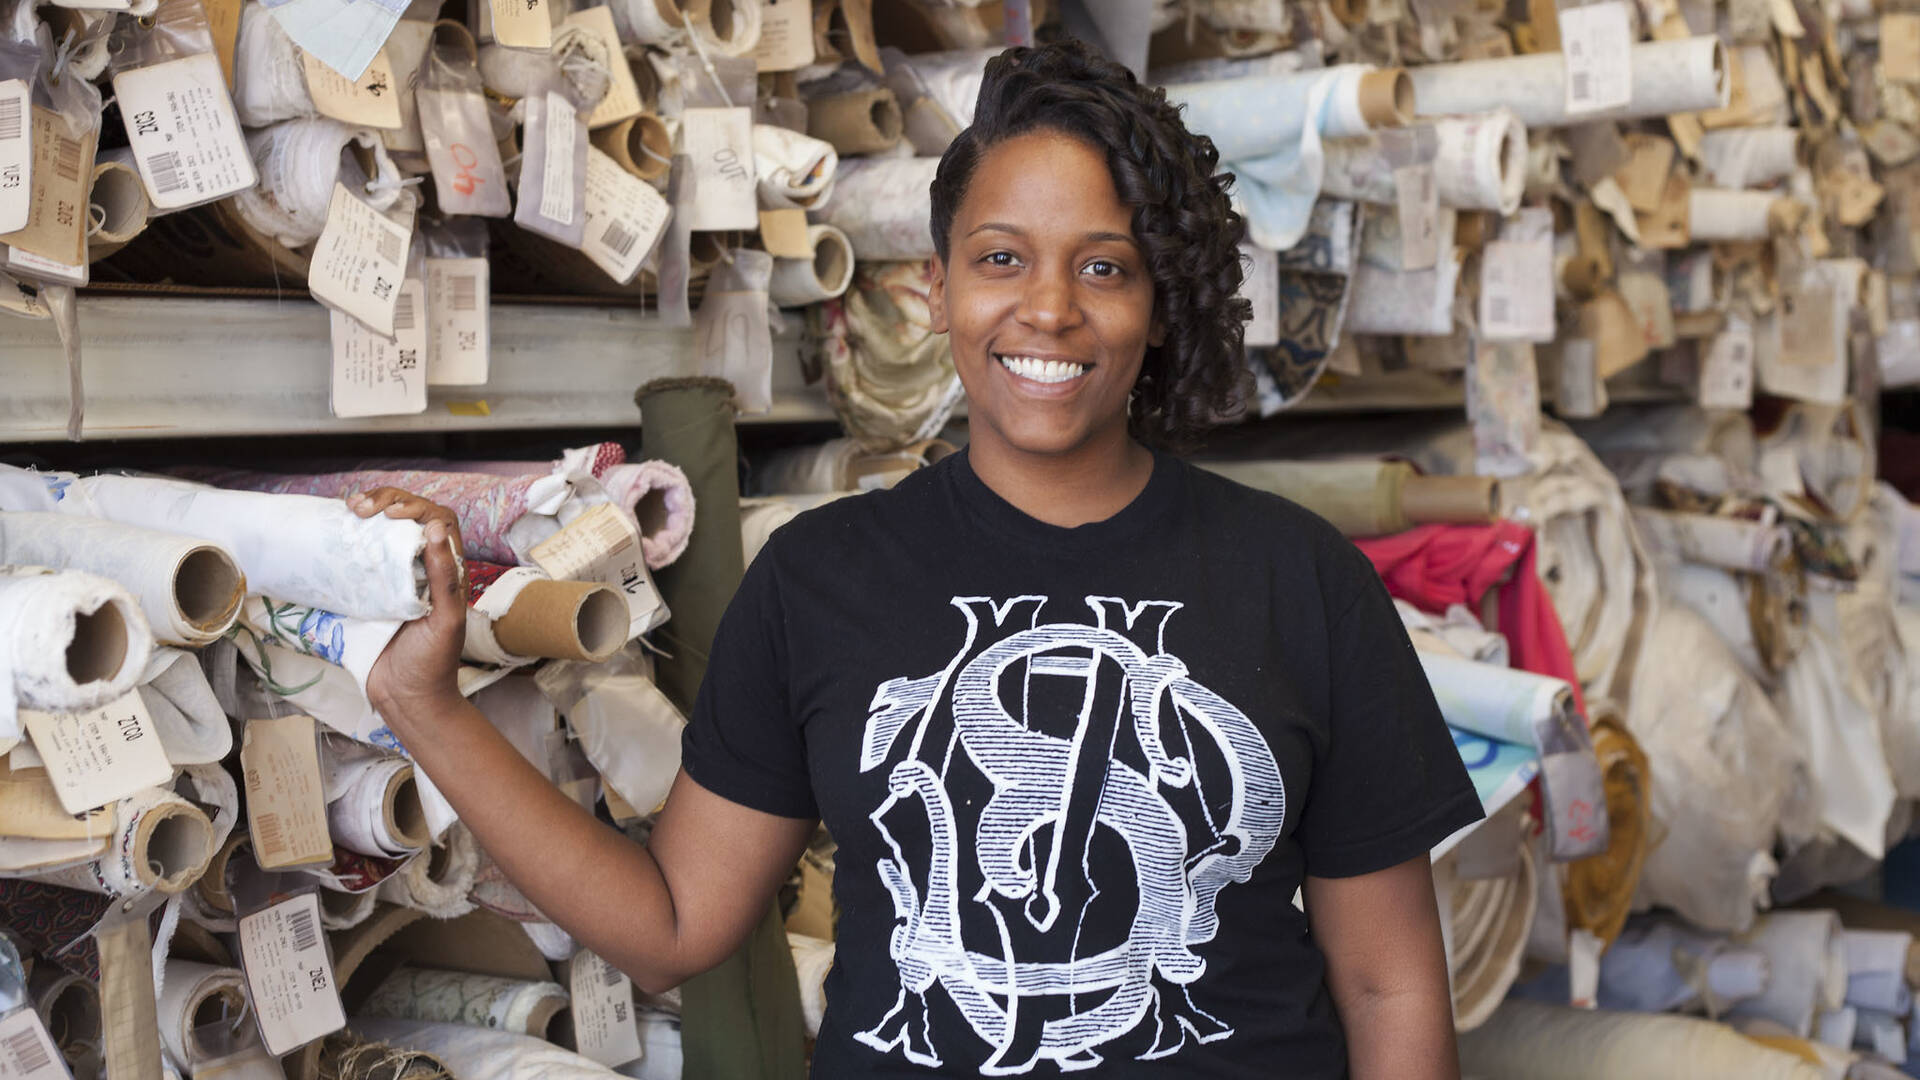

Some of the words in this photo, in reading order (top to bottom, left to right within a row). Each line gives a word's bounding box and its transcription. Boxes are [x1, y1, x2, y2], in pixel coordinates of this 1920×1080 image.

[134, 110, 159, 136] ZXC3
[713, 148, 748, 181] OUT
[309, 966, 327, 992] ZNE2
